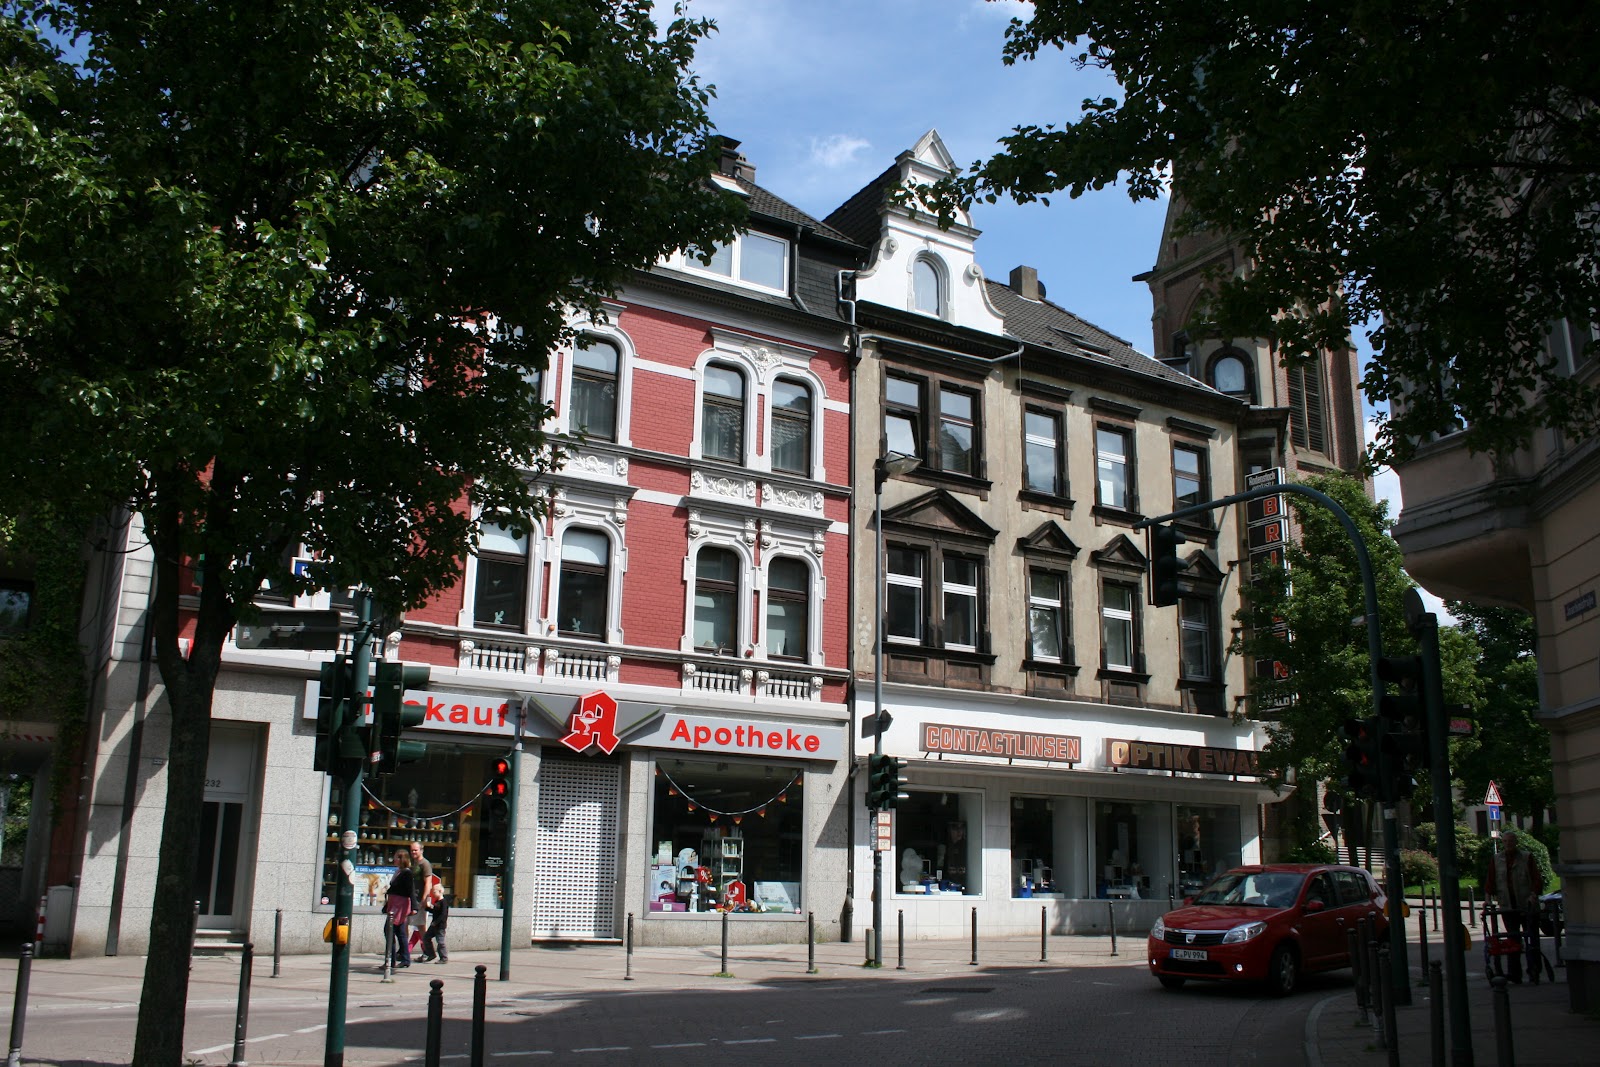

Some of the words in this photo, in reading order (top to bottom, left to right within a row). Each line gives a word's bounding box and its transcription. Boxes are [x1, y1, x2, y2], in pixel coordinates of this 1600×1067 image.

[670, 719, 821, 753] Apotheke
[926, 726, 1080, 761] CONTACTLINSEN
[1111, 742, 1193, 771] OPTIK
[1202, 750, 1277, 777] EWA
[204, 779, 221, 788] 232
